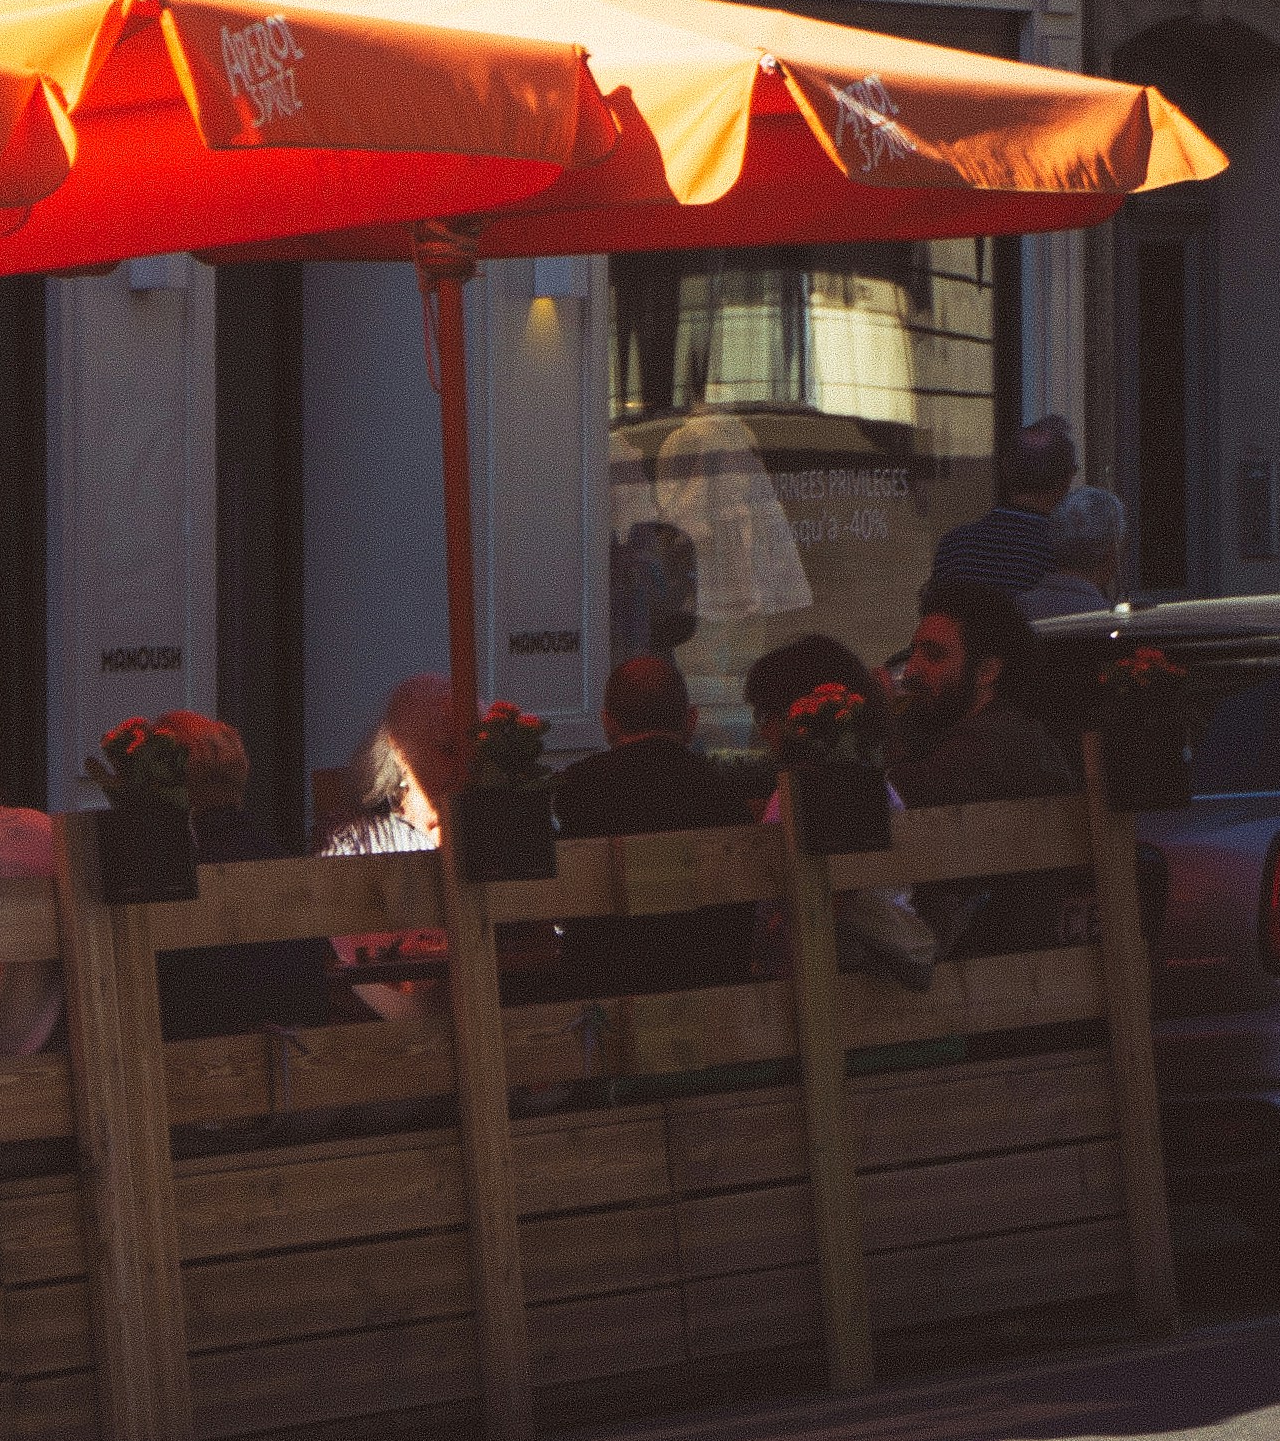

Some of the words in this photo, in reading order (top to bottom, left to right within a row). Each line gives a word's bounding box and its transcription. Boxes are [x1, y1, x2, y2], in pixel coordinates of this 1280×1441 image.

[219, 13, 306, 98] APEROL
[508, 629, 581, 655] MANOUSH
[100, 645, 183, 673] MANOUSH
